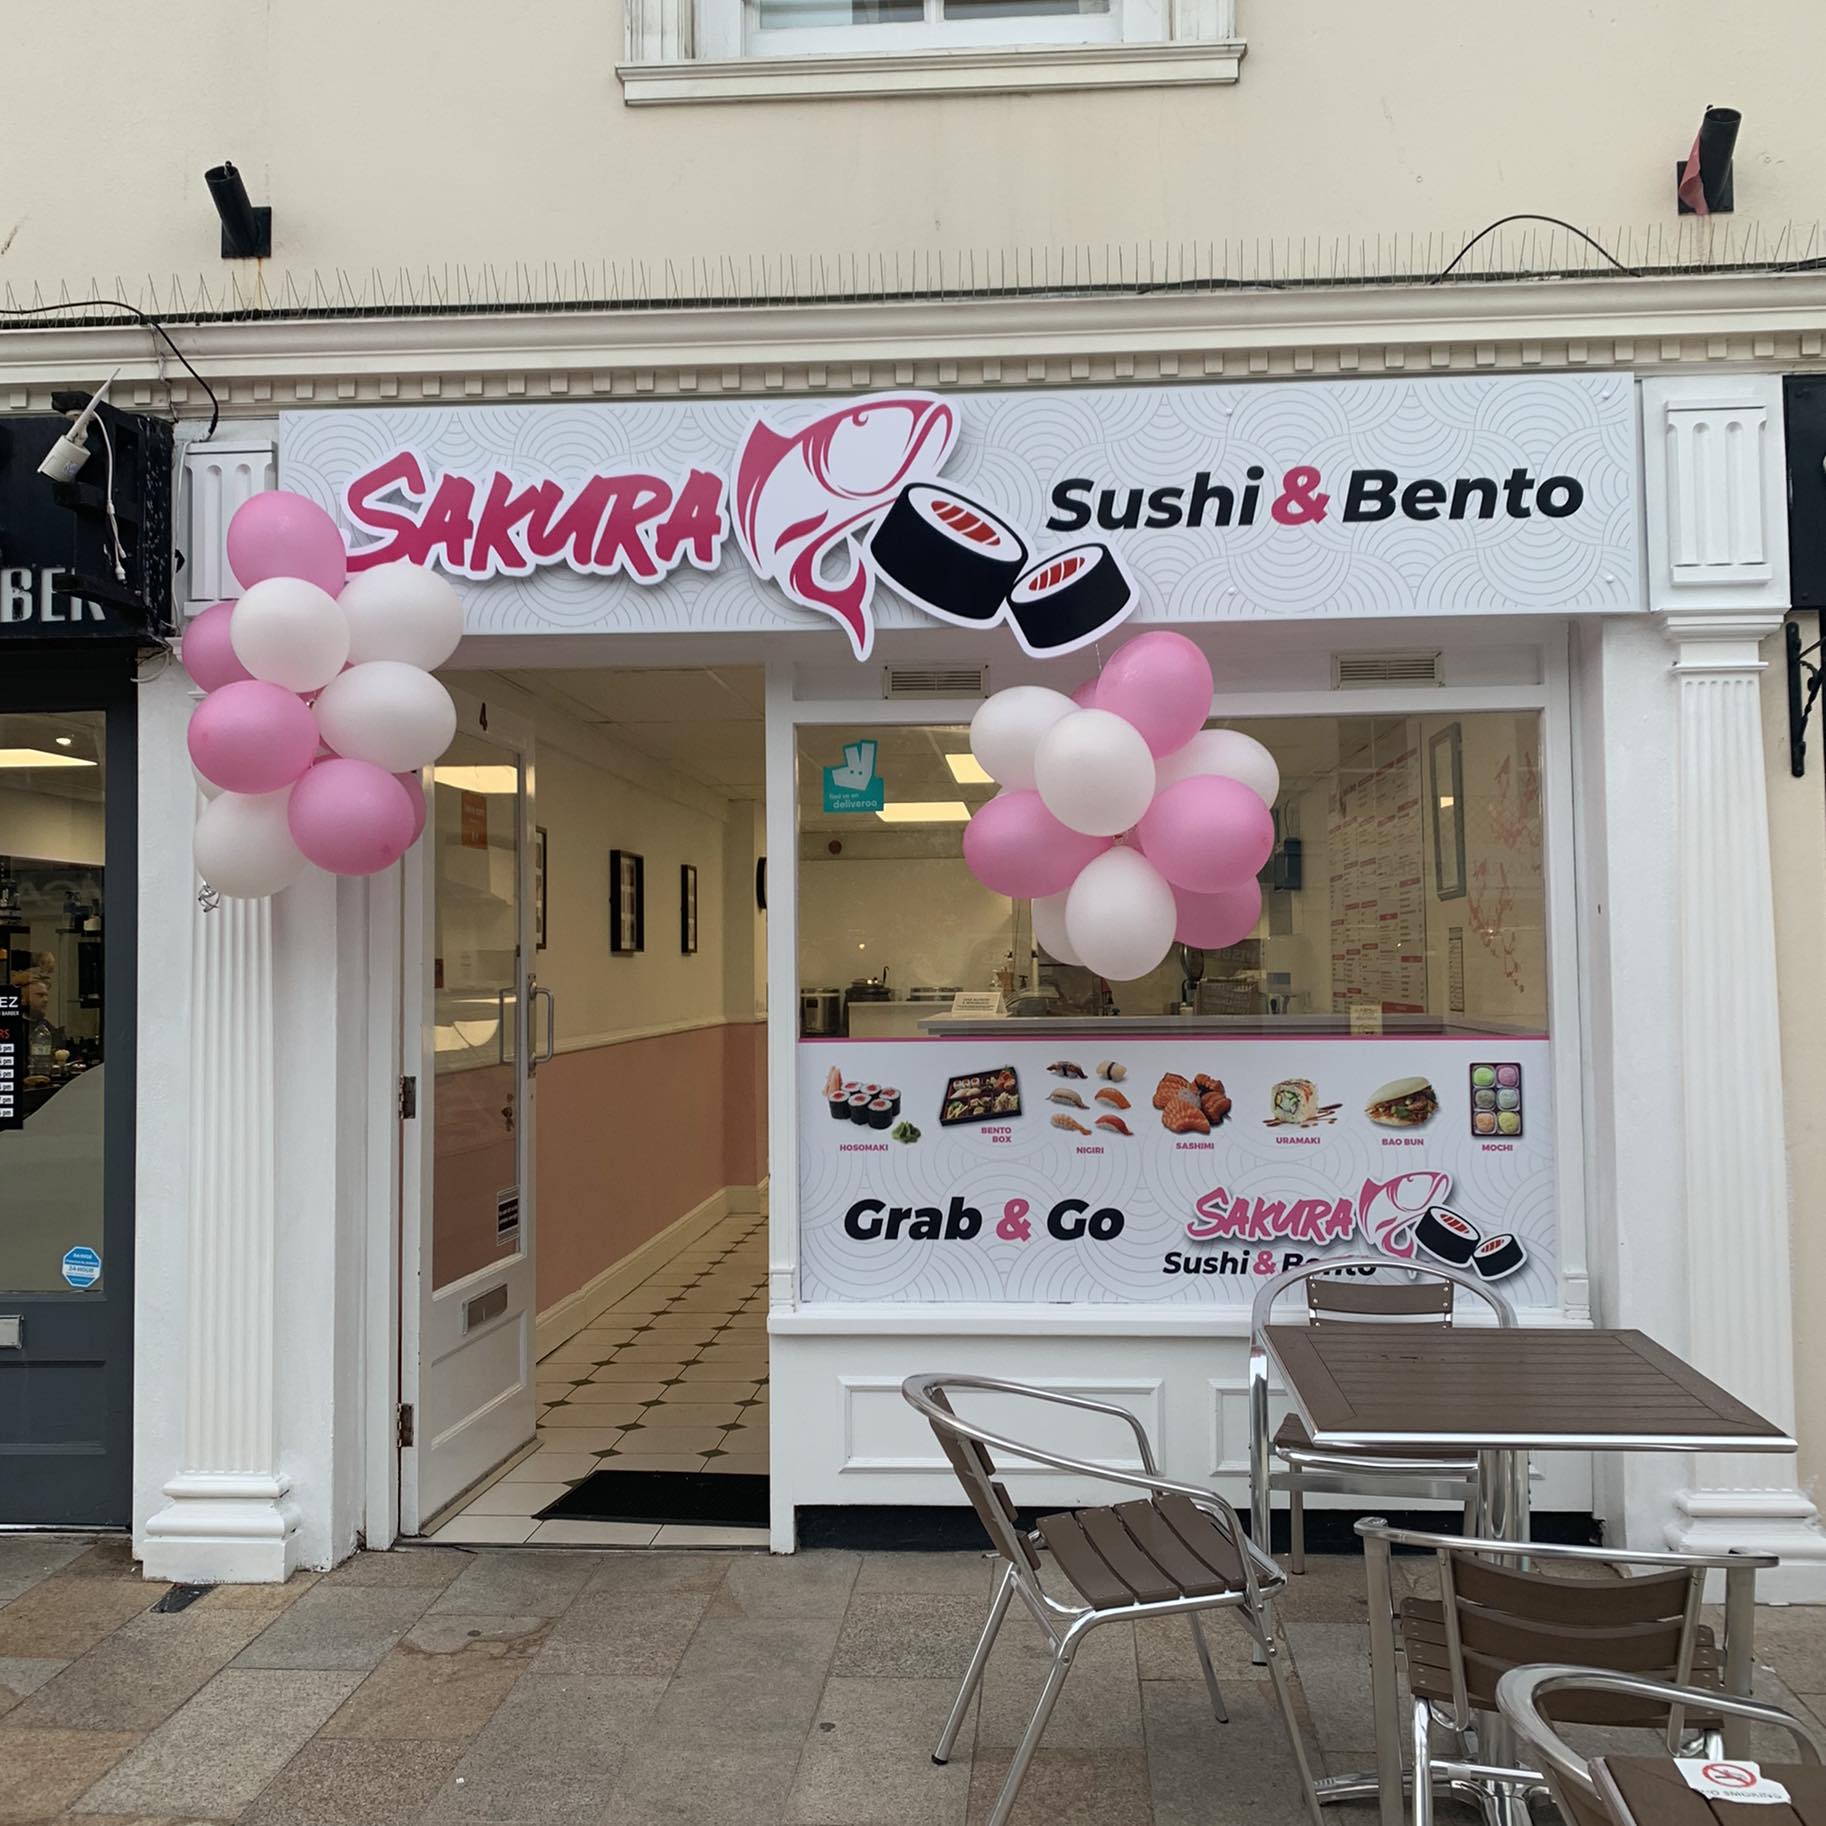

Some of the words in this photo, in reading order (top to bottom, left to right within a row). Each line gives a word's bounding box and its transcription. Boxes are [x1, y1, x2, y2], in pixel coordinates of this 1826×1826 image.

[1046, 466, 1264, 532] Sushi
[1270, 465, 1330, 526] &
[1342, 468, 1584, 523] Bento
[346, 452, 722, 577] SAKURA
[833, 799, 878, 809] deliveroo
[981, 1126, 1012, 1134] BENTO
[992, 1134, 1012, 1143] BOX
[1276, 1136, 1321, 1145] URAMAKI
[1381, 1138, 1402, 1146] BAO
[1404, 1138, 1425, 1146] BUN
[839, 1144, 889, 1153] HOSOMAKI
[1076, 1146, 1104, 1154] NIGIRI
[1175, 1142, 1215, 1151] SASHIMI
[1481, 1143, 1513, 1152] MOCHI
[844, 1196, 983, 1241] Grab
[995, 1198, 1031, 1242] &
[1046, 1199, 1125, 1241] Go
[1187, 1187, 1353, 1243] SAKURA
[1162, 1250, 1251, 1275] Sushi
[1252, 1251, 1277, 1276] &
